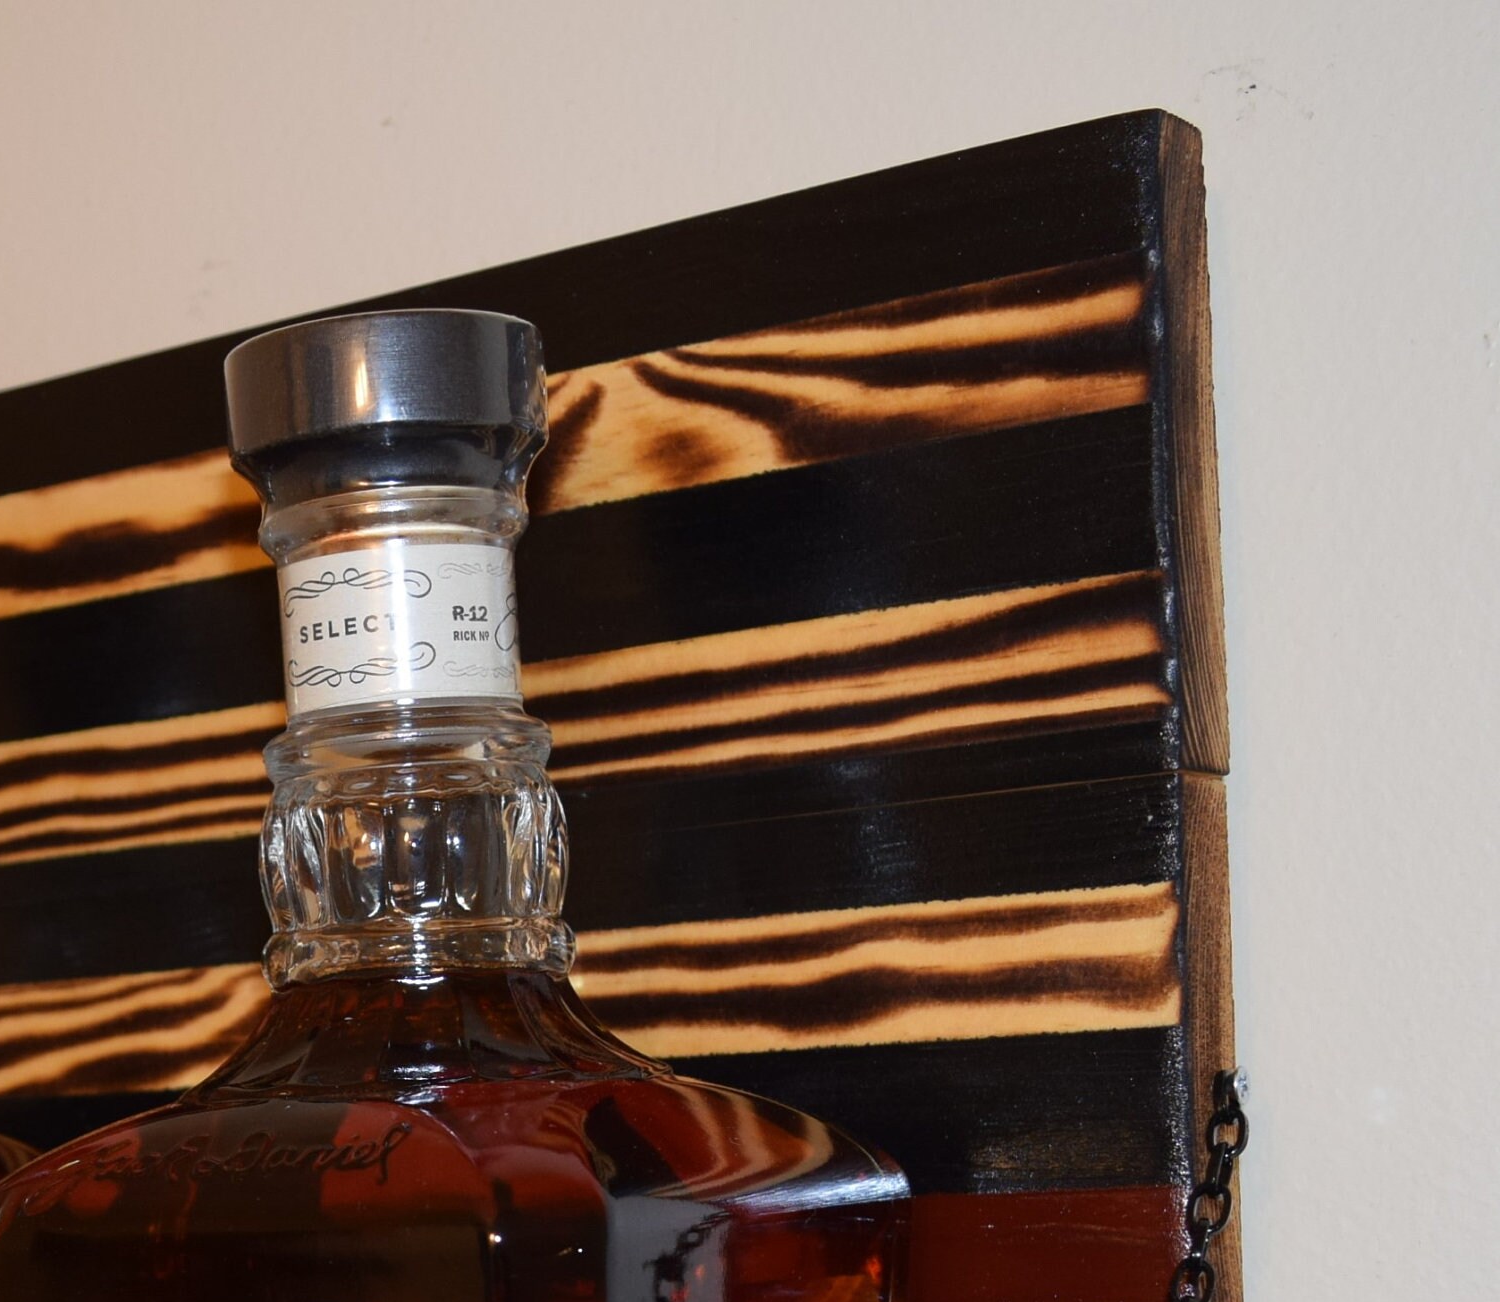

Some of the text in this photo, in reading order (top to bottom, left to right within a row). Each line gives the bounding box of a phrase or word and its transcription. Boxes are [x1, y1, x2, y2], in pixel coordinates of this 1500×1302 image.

[452, 605, 488, 621] R-12
[300, 612, 395, 644] SELECT
[453, 630, 476, 641] RICK
